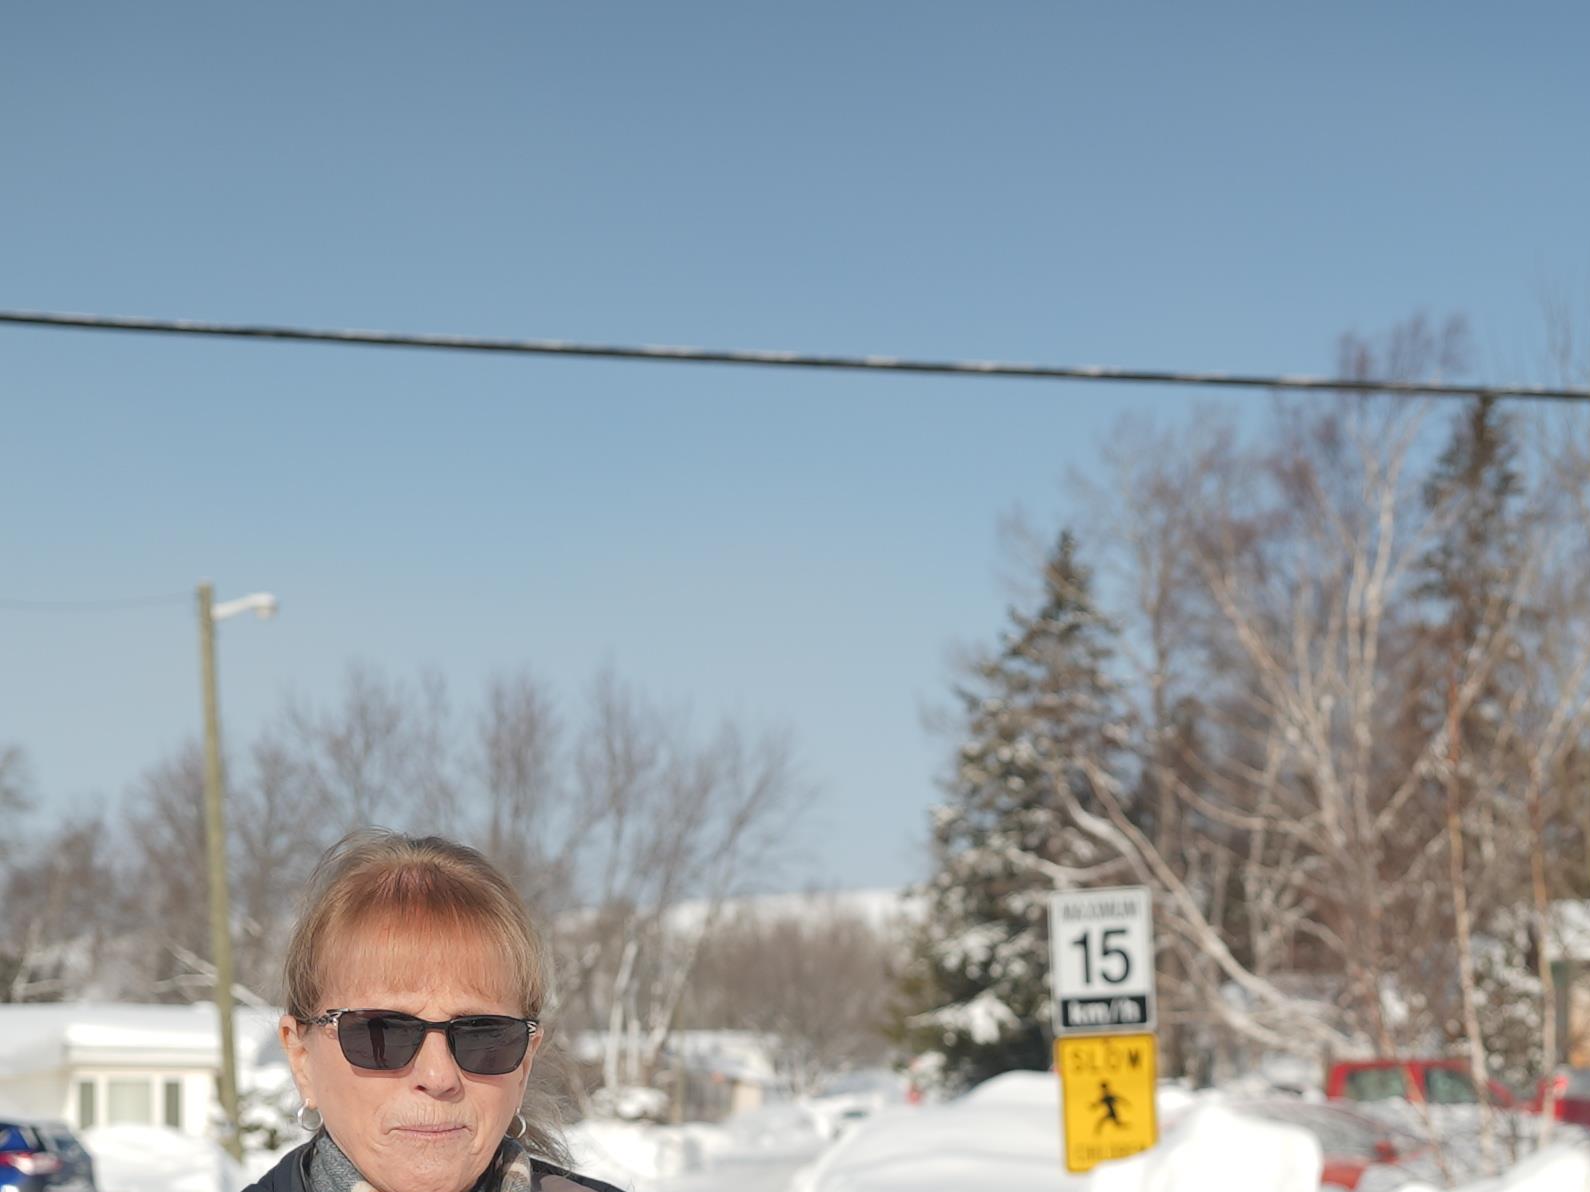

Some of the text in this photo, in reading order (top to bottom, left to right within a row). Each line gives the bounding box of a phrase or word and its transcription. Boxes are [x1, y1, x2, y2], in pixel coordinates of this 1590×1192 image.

[1071, 927, 1131, 985] 15
[1068, 997, 1140, 1025] km/h
[1071, 1048, 1143, 1074] SLOW
